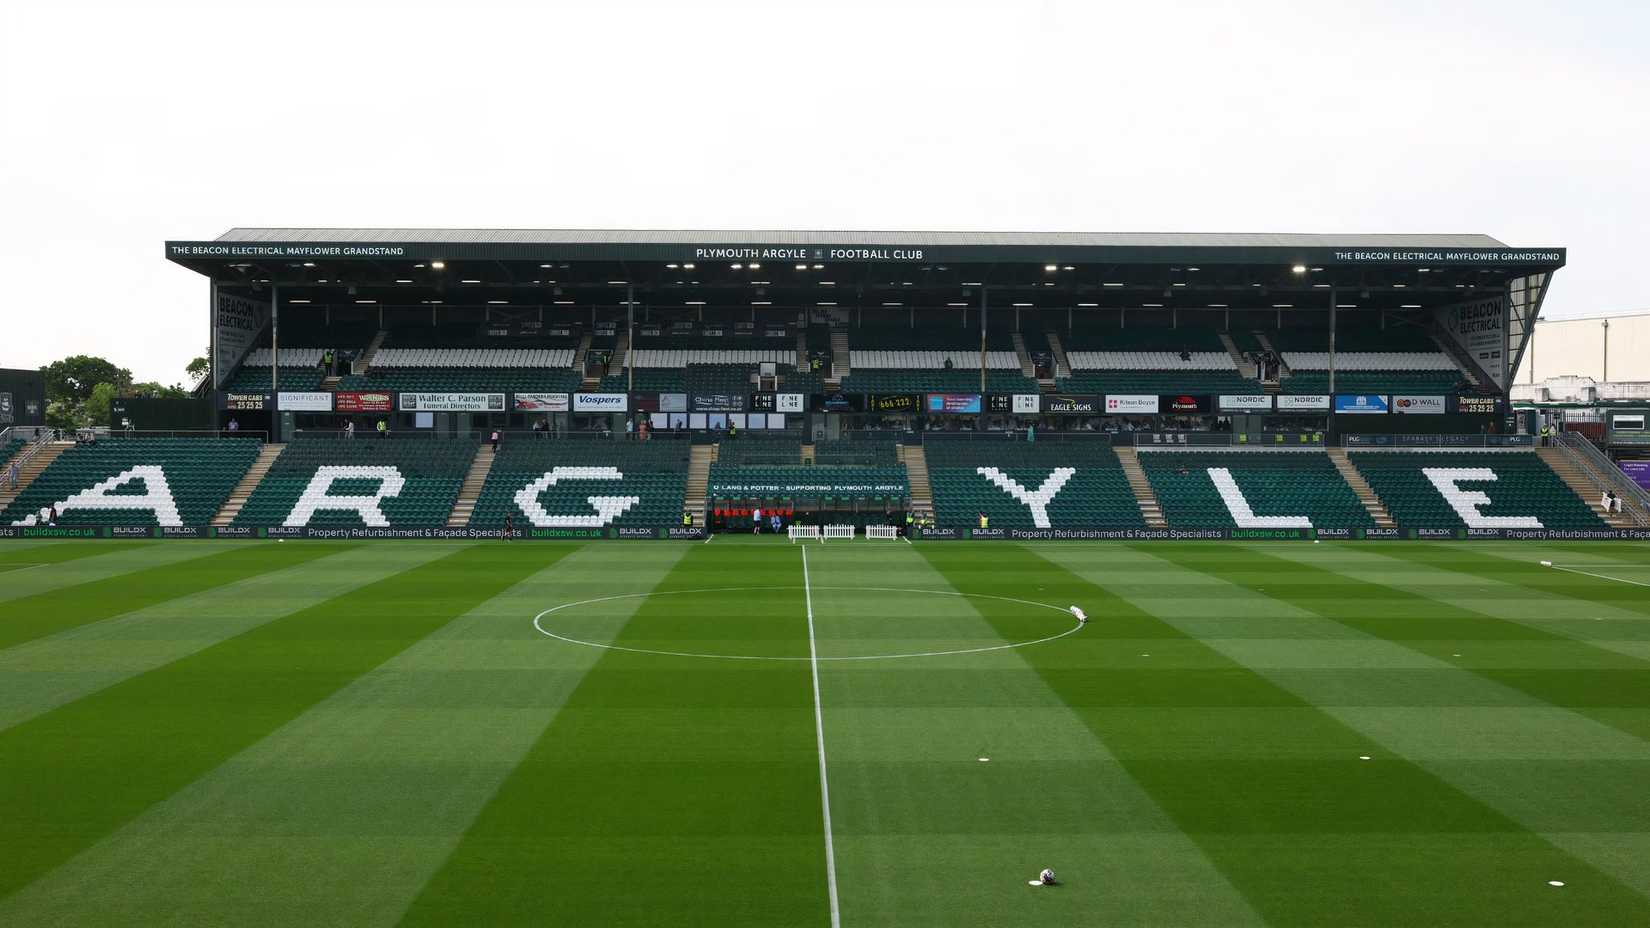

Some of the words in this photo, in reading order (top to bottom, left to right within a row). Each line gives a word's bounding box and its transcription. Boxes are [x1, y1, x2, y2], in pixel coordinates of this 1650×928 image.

[172, 246, 190, 255] THE
[192, 246, 229, 255] BEACON
[232, 246, 284, 256] ELECTRICAL
[287, 247, 341, 256] MAYFLOWER
[343, 247, 404, 256] GRANDSTAND
[696, 249, 759, 258] PLYMOUTH
[762, 249, 806, 258] ARGYLE
[830, 249, 890, 259] FOOTBALL
[893, 250, 923, 259] CLUB
[1335, 252, 1352, 260] THE
[1355, 252, 1390, 260] BEACON
[1393, 252, 1443, 261] ELECTRICAL
[1446, 252, 1499, 261] MAYFLOWER
[1501, 253, 1560, 261] GRANDSTAND
[219, 296, 254, 316] BEACON
[1460, 300, 1501, 320] BEACON
[1460, 318, 1501, 333] ELECTRICAL
[418, 394, 446, 402] Walter
[459, 394, 486, 402] Parson
[579, 395, 622, 405] Vospers
[1050, 403, 1071, 411] EAGLE
[1072, 403, 1092, 411] SIGNS
[308, 528, 351, 538] Property
[352, 527, 423, 537] Refurbishment
[425, 528, 431, 536] &
[433, 528, 468, 539] Façade
[1011, 529, 1053, 539] Property
[1054, 528, 1125, 538] Refurbishment
[1126, 529, 1133, 538] &
[1135, 529, 1168, 540] Façade
[1170, 529, 1222, 540] Specialists
[1506, 530, 1547, 540] Property
[1549, 529, 1618, 538] Refurbishment
[1620, 529, 1627, 538] &
